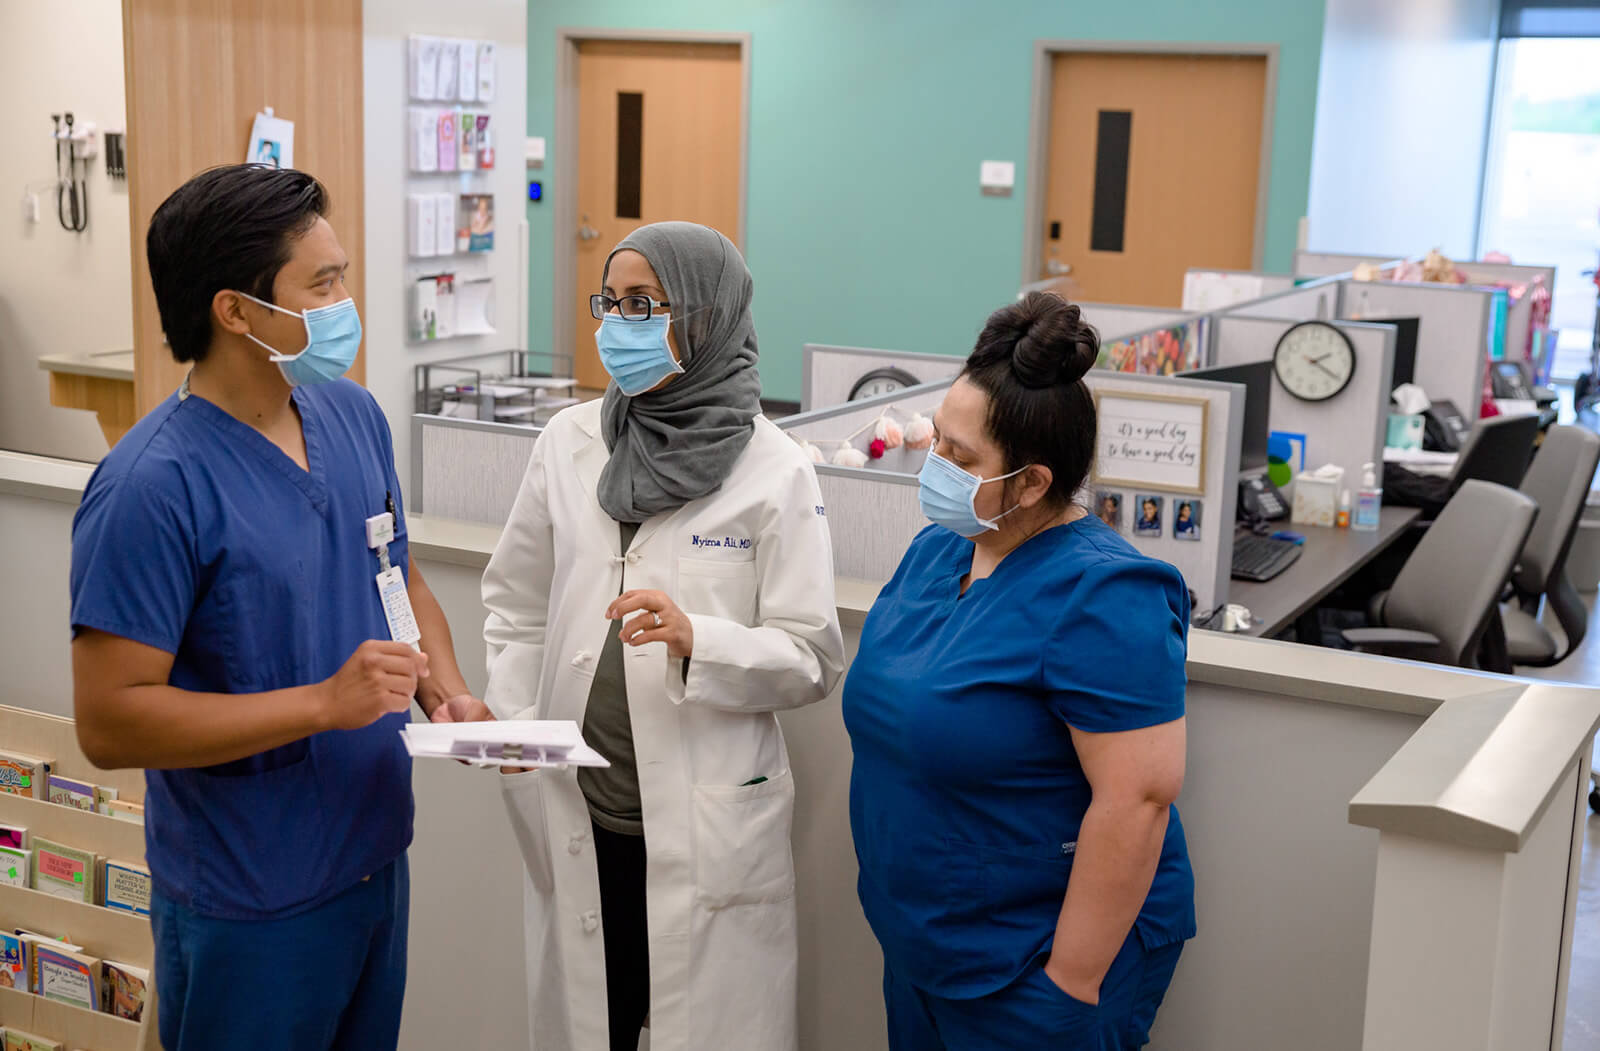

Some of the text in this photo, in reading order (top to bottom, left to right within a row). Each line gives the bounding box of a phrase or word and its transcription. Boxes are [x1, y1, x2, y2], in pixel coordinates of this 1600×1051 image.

[1145, 422, 1168, 440] good
[1169, 424, 1187, 444] day
[1109, 443, 1117, 456] to
[1122, 442, 1142, 458] have
[1153, 445, 1177, 463] good
[1178, 445, 1195, 466] day
[739, 538, 752, 549] MD
